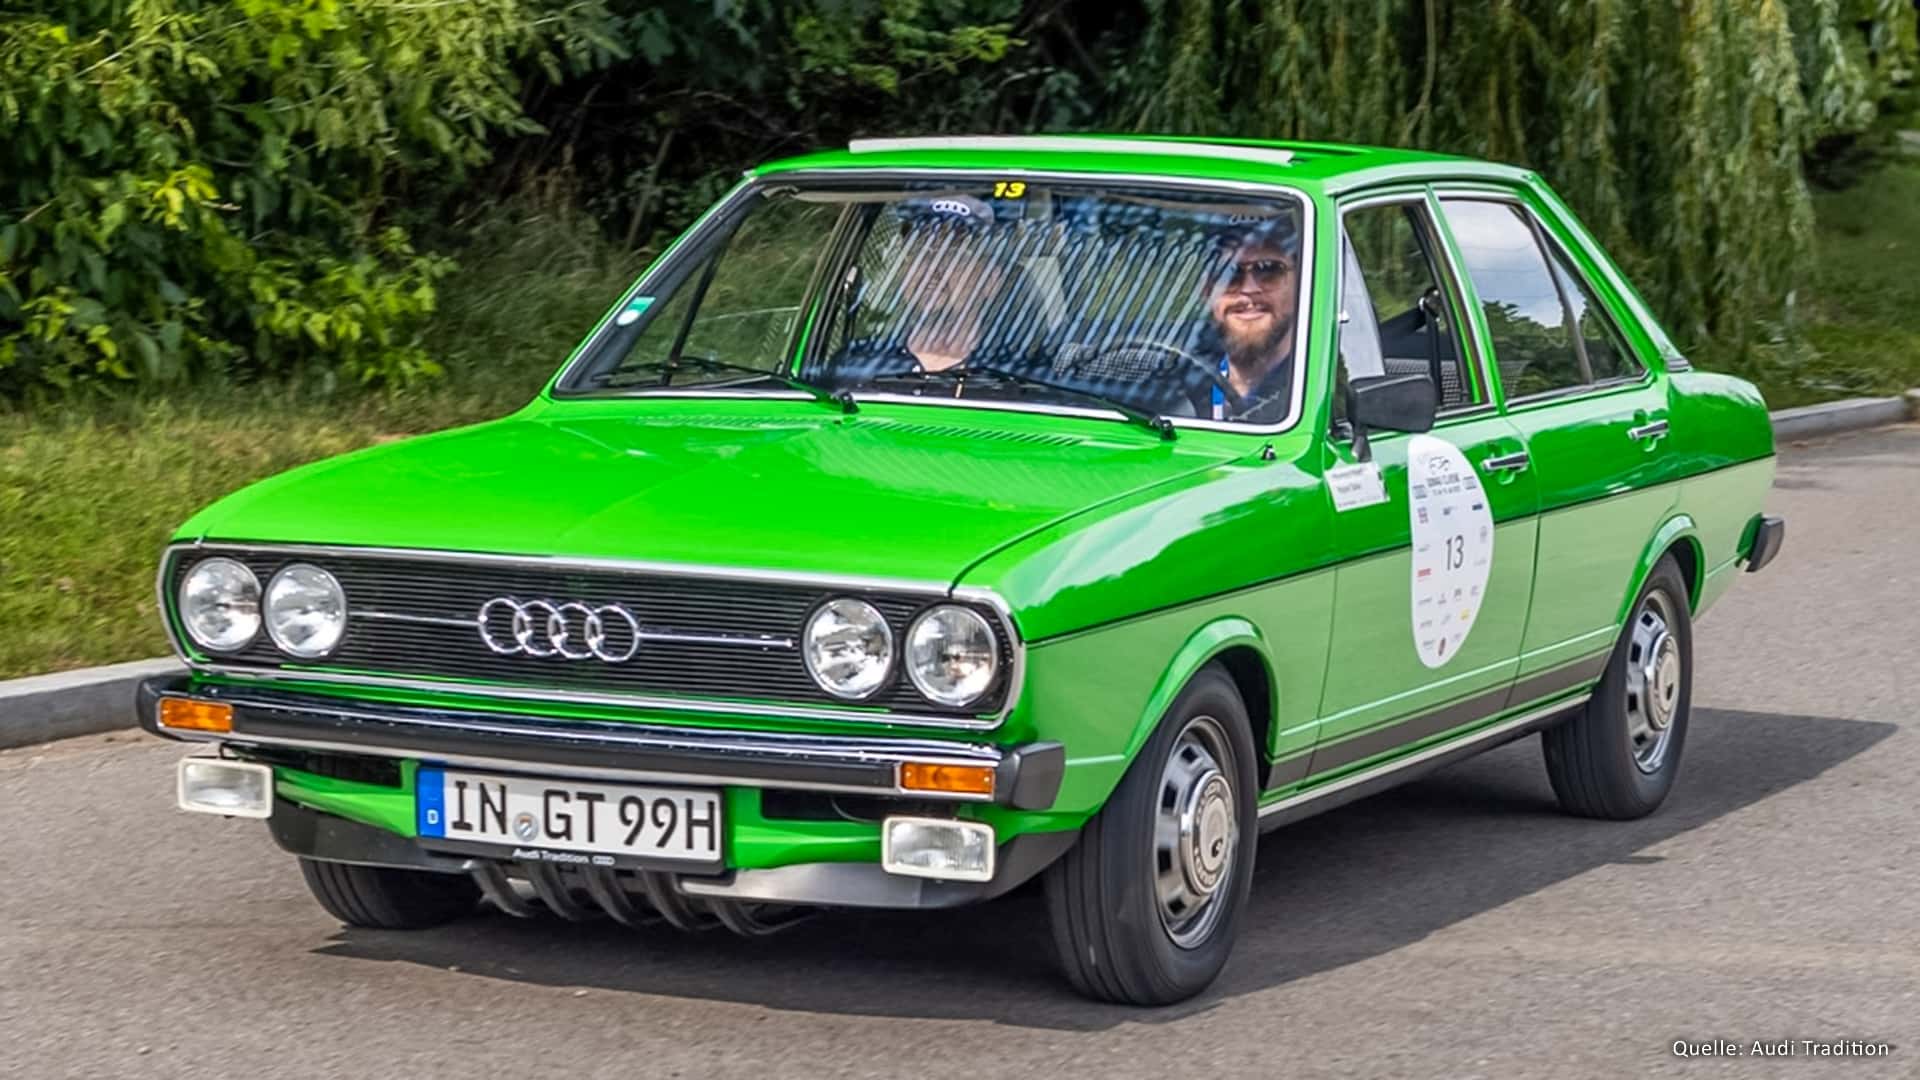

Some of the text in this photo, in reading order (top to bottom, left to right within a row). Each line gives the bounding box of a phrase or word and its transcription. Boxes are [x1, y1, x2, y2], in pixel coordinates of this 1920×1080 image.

[992, 181, 1027, 199] 13
[1445, 535, 1465, 571] 13
[451, 780, 507, 834] IN
[543, 789, 606, 843] GT
[619, 795, 717, 852] 99H
[512, 848, 590, 864] Audi Tradition
